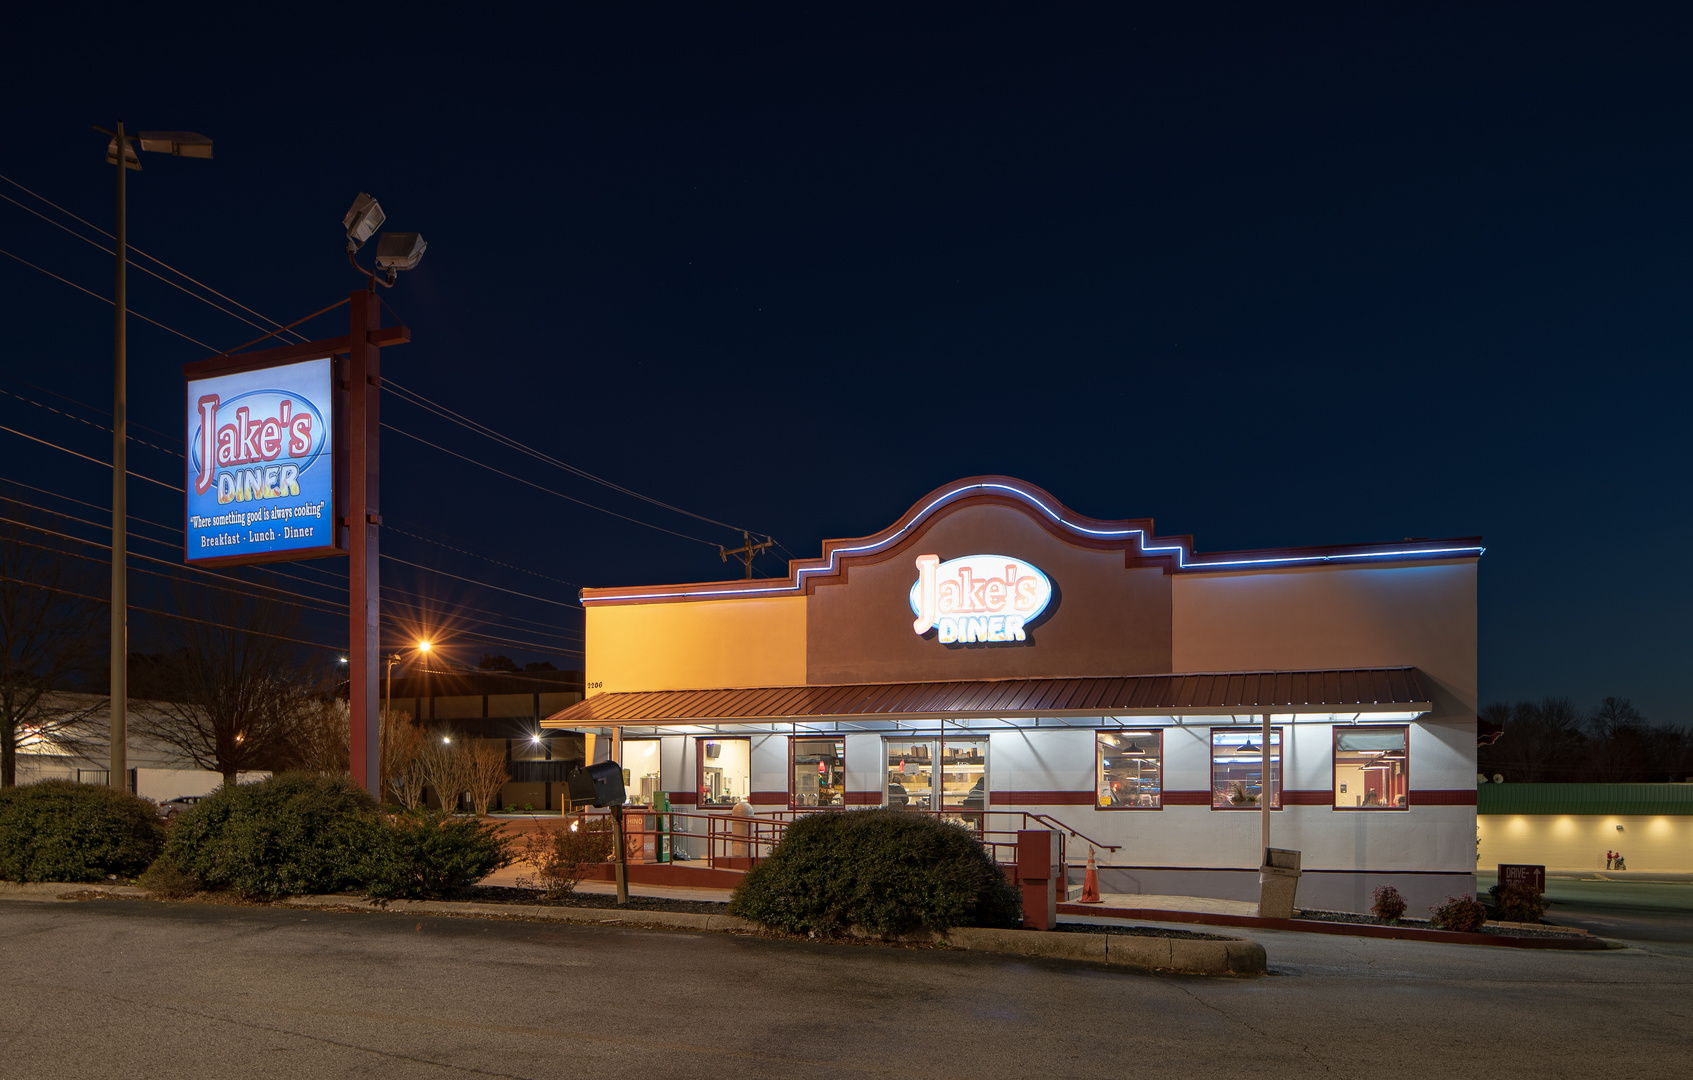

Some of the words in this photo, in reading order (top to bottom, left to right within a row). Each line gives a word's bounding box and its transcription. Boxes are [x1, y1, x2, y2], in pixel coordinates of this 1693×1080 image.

[195, 393, 312, 495] Jake's
[217, 463, 300, 505] DINER
[212, 510, 246, 527] something
[246, 507, 263, 527] good
[263, 506, 270, 521] is
[271, 505, 293, 522] always
[200, 532, 241, 548] Breakfast
[248, 528, 276, 543] Lunch
[283, 526, 314, 539] Dinner
[913, 554, 1038, 635] Jake's
[938, 614, 1026, 643] DINER
